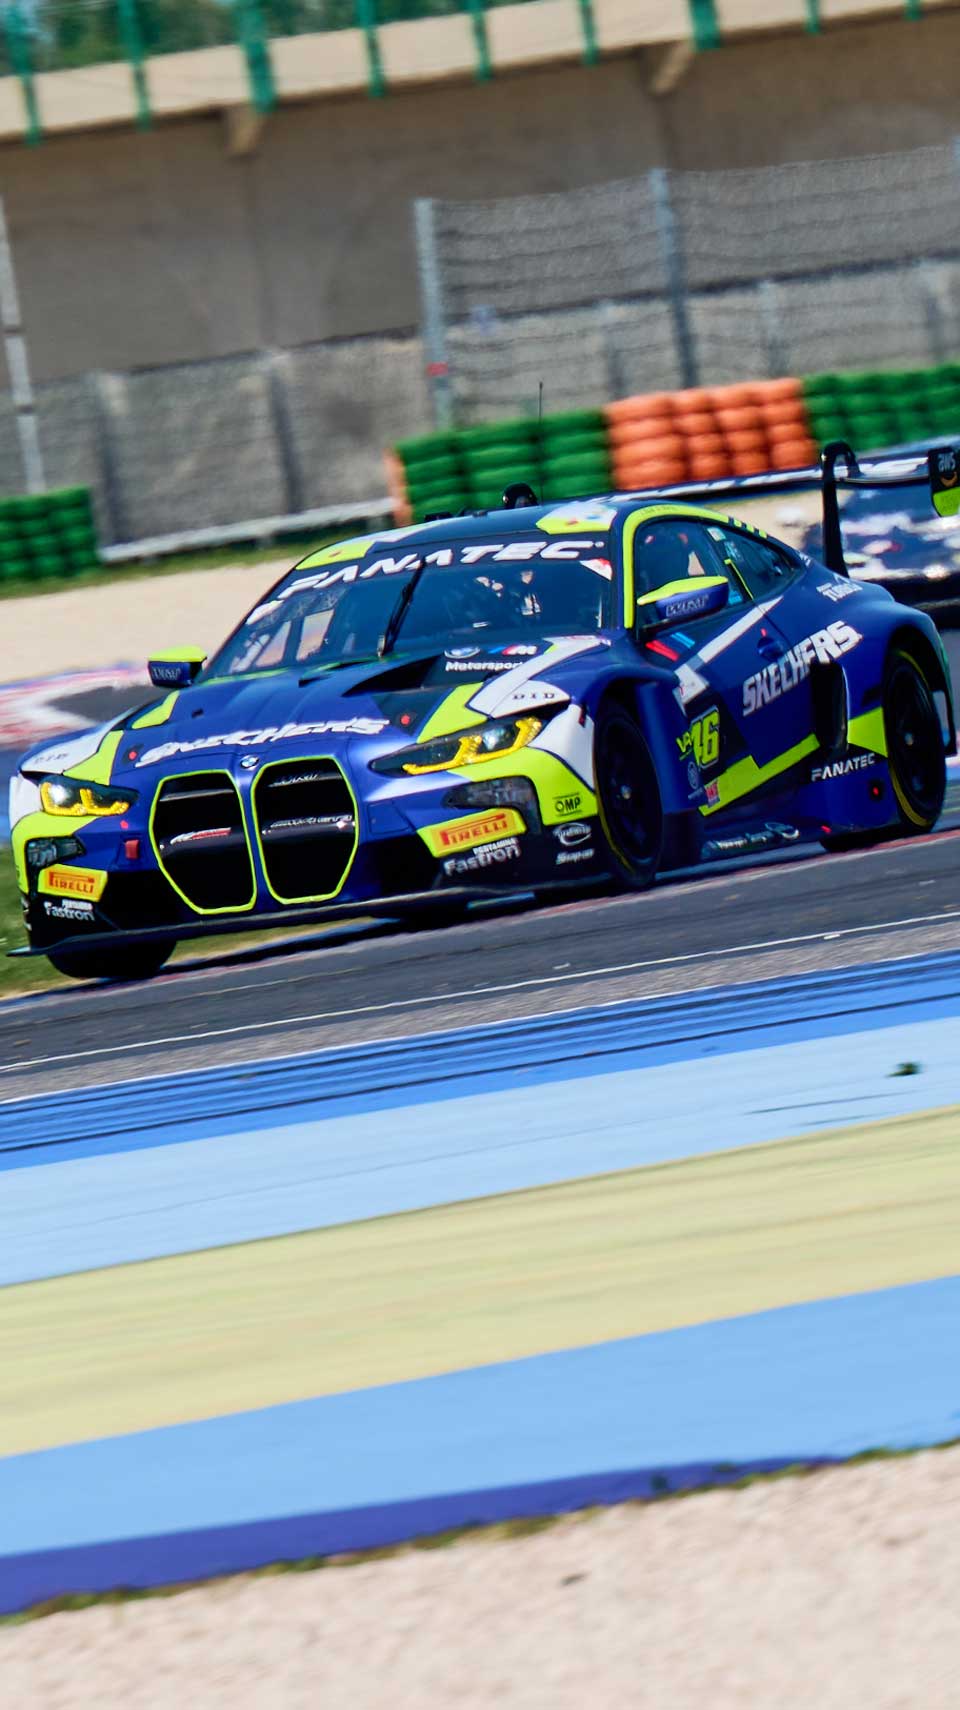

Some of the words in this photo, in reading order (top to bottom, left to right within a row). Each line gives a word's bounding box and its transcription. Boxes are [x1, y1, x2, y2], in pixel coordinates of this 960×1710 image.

[277, 540, 596, 599] FANATEC
[742, 619, 865, 717] SKECHERS
[134, 717, 391, 768] SKECHERS
[811, 752, 876, 782] FANATEC
[554, 796, 582, 813] OMP
[440, 813, 508, 847] PIRELLI
[443, 844, 522, 876] Fastron
[48, 871, 95, 894] PIRELLI
[43, 900, 96, 921] Fastron
